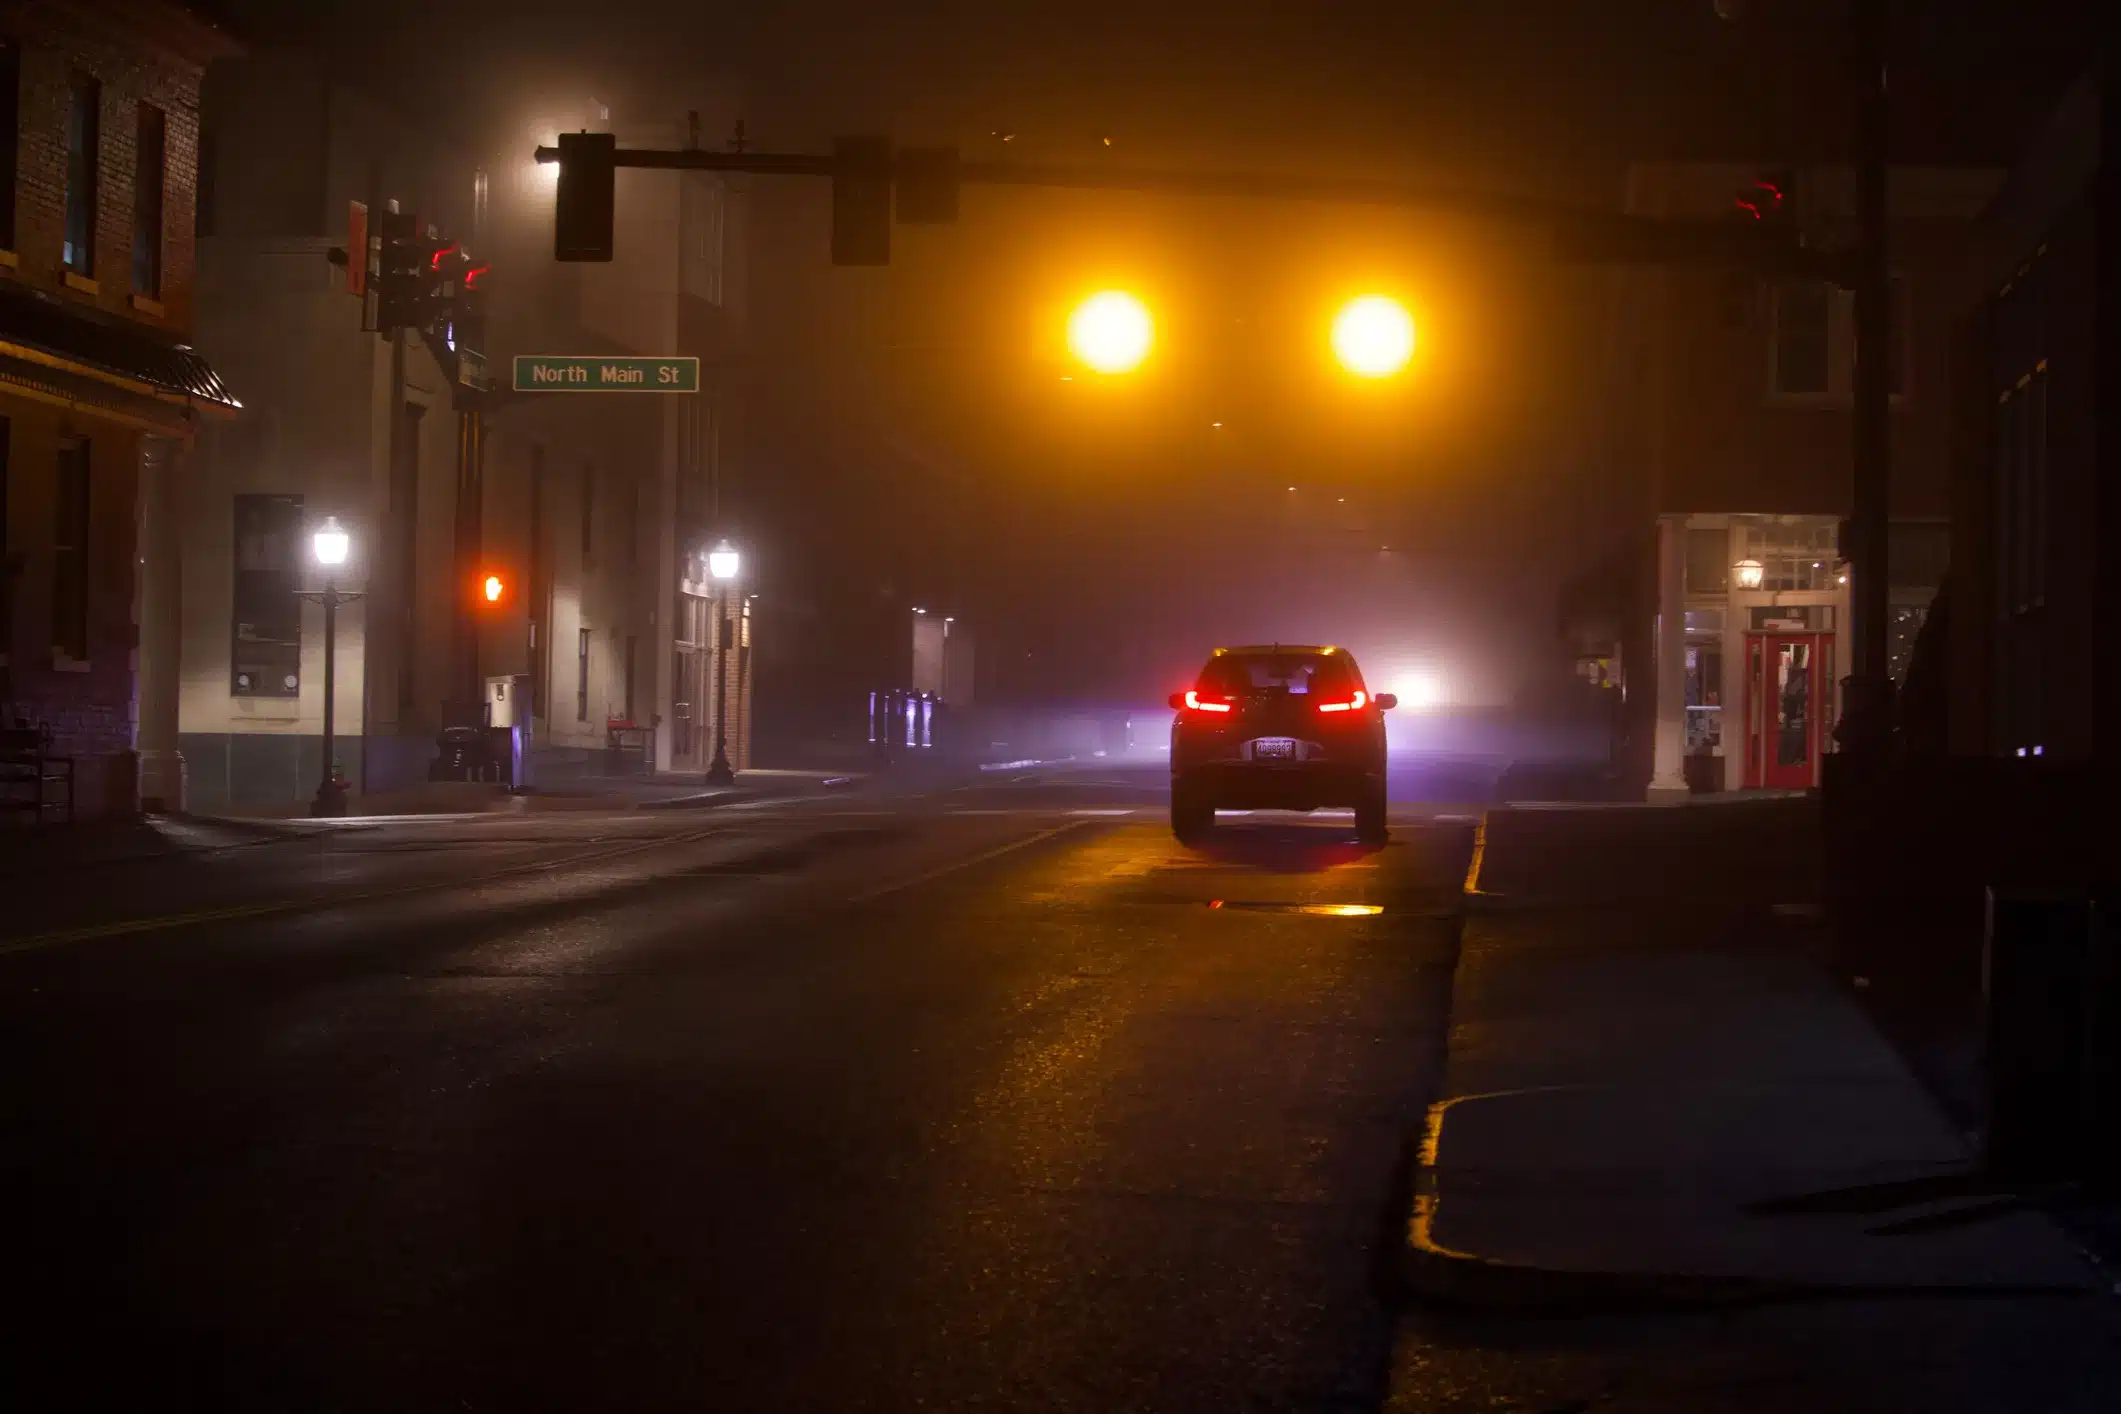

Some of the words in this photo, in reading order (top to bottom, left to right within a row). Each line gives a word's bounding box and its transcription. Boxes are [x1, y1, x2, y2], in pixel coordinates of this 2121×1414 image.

[533, 365, 588, 382] North
[601, 366, 644, 383] Main
[658, 366, 680, 383] St
